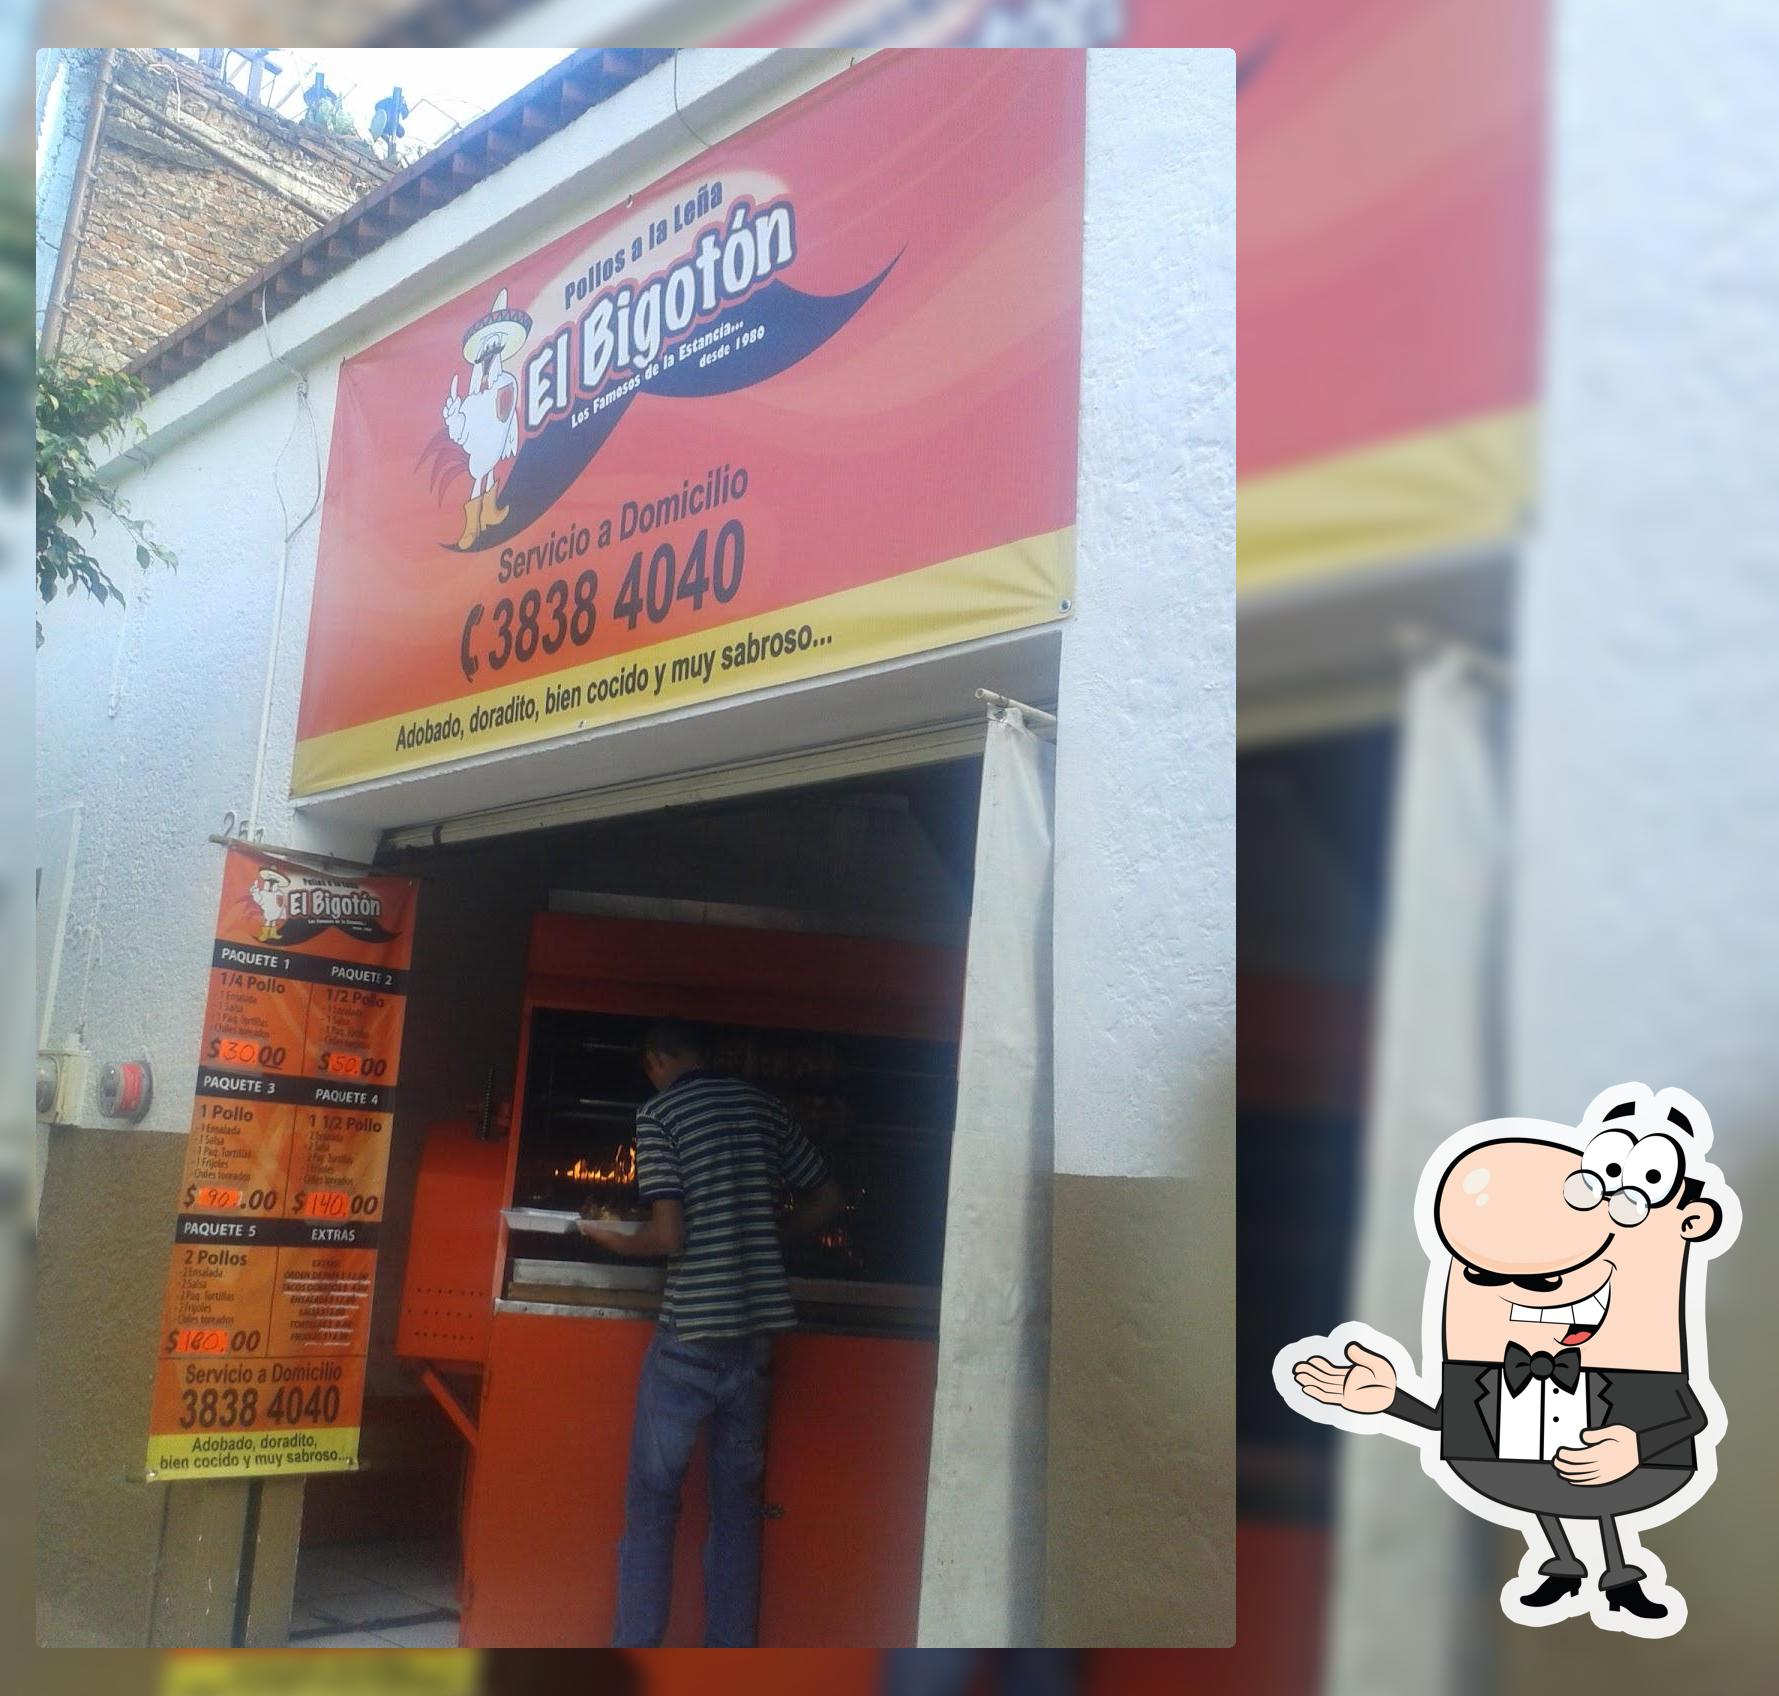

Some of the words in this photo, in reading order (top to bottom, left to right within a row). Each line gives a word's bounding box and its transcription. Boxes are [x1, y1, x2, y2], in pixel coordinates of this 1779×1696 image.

[565, 249, 625, 310] Pollos
[631, 237, 643, 262] a
[649, 218, 667, 250] la
[673, 180, 723, 234] Leña
[528, 330, 569, 427] El
[583, 207, 793, 386] Bigotón
[699, 341, 731, 368] desde
[735, 325, 765, 351] 1980
[571, 406, 590, 428] Los
[593, 372, 641, 413] Famosos
[645, 360, 659, 380] de
[663, 352, 675, 370] la
[679, 319, 744, 361] Estancia...
[498, 523, 590, 584] Servicio
[597, 519, 612, 548] a
[619, 463, 749, 542] Domicilio
[488, 569, 598, 670] 3838
[612, 518, 745, 631] 4040
[395, 719, 464, 752] Adobado,
[469, 696, 540, 734] doradito,
[545, 686, 581, 716] bien
[587, 663, 649, 706] cocido
[653, 663, 668, 696] y
[671, 650, 715, 685] muy
[720, 624, 833, 671] sabroso...
[290, 892, 307, 915] El
[312, 890, 380, 919] Bigotón
[222, 948, 278, 968] PAQUETE
[283, 958, 290, 970] 1
[221, 972, 242, 986] 1/4
[247, 976, 285, 994] Pollo
[331, 966, 382, 983] PAQUETE
[385, 975, 392, 985] 2
[327, 989, 349, 1003] 1/2
[353, 994, 385, 1008] Pollo
[204, 1075, 262, 1093] PAQUETE
[267, 1083, 275, 1094] 3
[315, 1088, 367, 1104] PAQUETE
[371, 1094, 378, 1105] 4
[201, 1104, 207, 1117] 1
[212, 1105, 253, 1121] Pollo
[207, 1124, 240, 1135] Ensalada
[310, 1115, 316, 1127] 1
[324, 1116, 342, 1130] 1/2
[347, 1117, 382, 1133] Pollo
[205, 1135, 224, 1145] Salsa
[184, 1222, 243, 1236] PAQUETE
[248, 1225, 256, 1237] 5
[312, 1229, 355, 1241] EXTRAS
[184, 1250, 193, 1265] 2
[198, 1250, 248, 1266] Pollos
[185, 1363, 253, 1384] Servicio
[257, 1370, 266, 1383] a
[272, 1361, 342, 1381] Domicilio
[179, 1388, 258, 1429] 3838
[267, 1385, 340, 1425] 4040
[192, 1436, 256, 1453] Adobado,
[260, 1433, 317, 1449] doradito,
[160, 1456, 189, 1470] bien
[194, 1453, 239, 1468] cocido
[243, 1455, 250, 1469] y
[255, 1453, 283, 1467] muy
